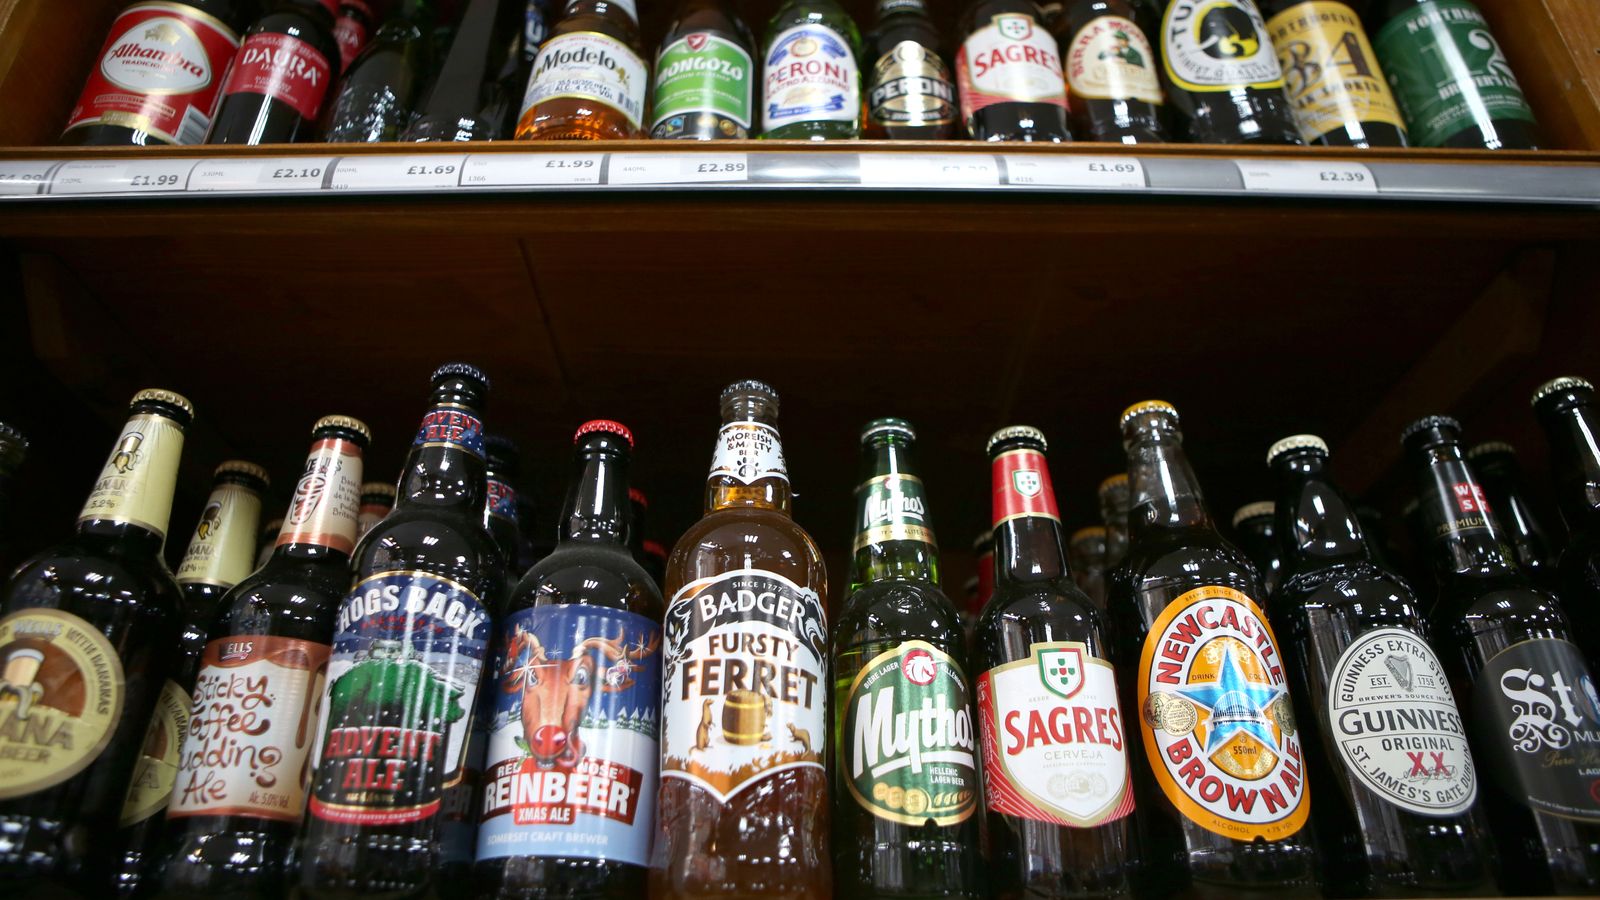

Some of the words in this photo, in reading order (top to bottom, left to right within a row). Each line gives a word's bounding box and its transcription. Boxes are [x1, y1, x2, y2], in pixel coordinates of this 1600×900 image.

[107, 43, 204, 78] Alhambra
[242, 47, 317, 87] DAURA
[541, 47, 616, 73] Modelo
[974, 44, 1063, 79] SAGRES
[657, 56, 743, 84] MONGOZO
[766, 60, 848, 92] PERONI
[407, 165, 456, 175] £1.69
[545, 160, 594, 168] £1.99
[697, 163, 746, 172] £2.89
[1088, 163, 1136, 173] £1.69
[130, 174, 178, 187] £1.99
[272, 168, 321, 179] £2.10
[1320, 171, 1365, 182] £2.39
[426, 426, 465, 440] ALE
[726, 432, 773, 446] MOREISH
[727, 442, 735, 451] &
[732, 581, 759, 589] SINCE
[338, 585, 400, 634] HOGS
[405, 585, 483, 640] BACK
[699, 590, 806, 624] BADGER
[224, 642, 254, 654] ELLS
[708, 632, 800, 663] FURSTY
[1155, 606, 1285, 687] NEWCASTLE
[66, 626, 97, 657] WITH
[91, 652, 113, 717] BANANAS
[879, 662, 900, 676] LAGER
[1341, 643, 1385, 703] GUINNESS
[1387, 640, 1427, 663] EXTRA
[681, 658, 818, 710] FERRET
[1191, 673, 1216, 681] DRINK
[1370, 676, 1391, 686] EST.
[1417, 676, 1435, 687] 1759
[192, 673, 275, 711] Sticky
[1358, 693, 1402, 702] BREWER'S
[1338, 708, 1467, 737] GUINNESS
[853, 686, 976, 780] Mythos
[1004, 706, 1123, 756] SAGRES
[325, 727, 443, 762] ADVENT
[1233, 745, 1257, 756] 550ml
[1381, 737, 1455, 752] ORIGINAL
[179, 736, 283, 789] udding
[1043, 750, 1103, 761] CERVEJA
[342, 758, 407, 791] ALE
[497, 763, 523, 778] RED
[929, 766, 958, 777] HELLENIC
[1166, 737, 1289, 815] BROWN
[1279, 737, 1302, 797] ALE
[1352, 744, 1371, 769] ST.
[1369, 767, 1432, 803] JAMES'S
[1436, 784, 1465, 803] GATE
[181, 770, 229, 806] Ale
[930, 776, 951, 785] LAGER
[951, 777, 965, 787] BEER
[484, 772, 630, 816] REINBEER
[518, 807, 547, 822] XMAS
[550, 807, 570, 821] ALE
[1212, 819, 1251, 834] ALCOHOL
[487, 831, 529, 845] SOMERSET
[530, 831, 565, 843] CRAFT
[565, 831, 609, 845] BREWER
